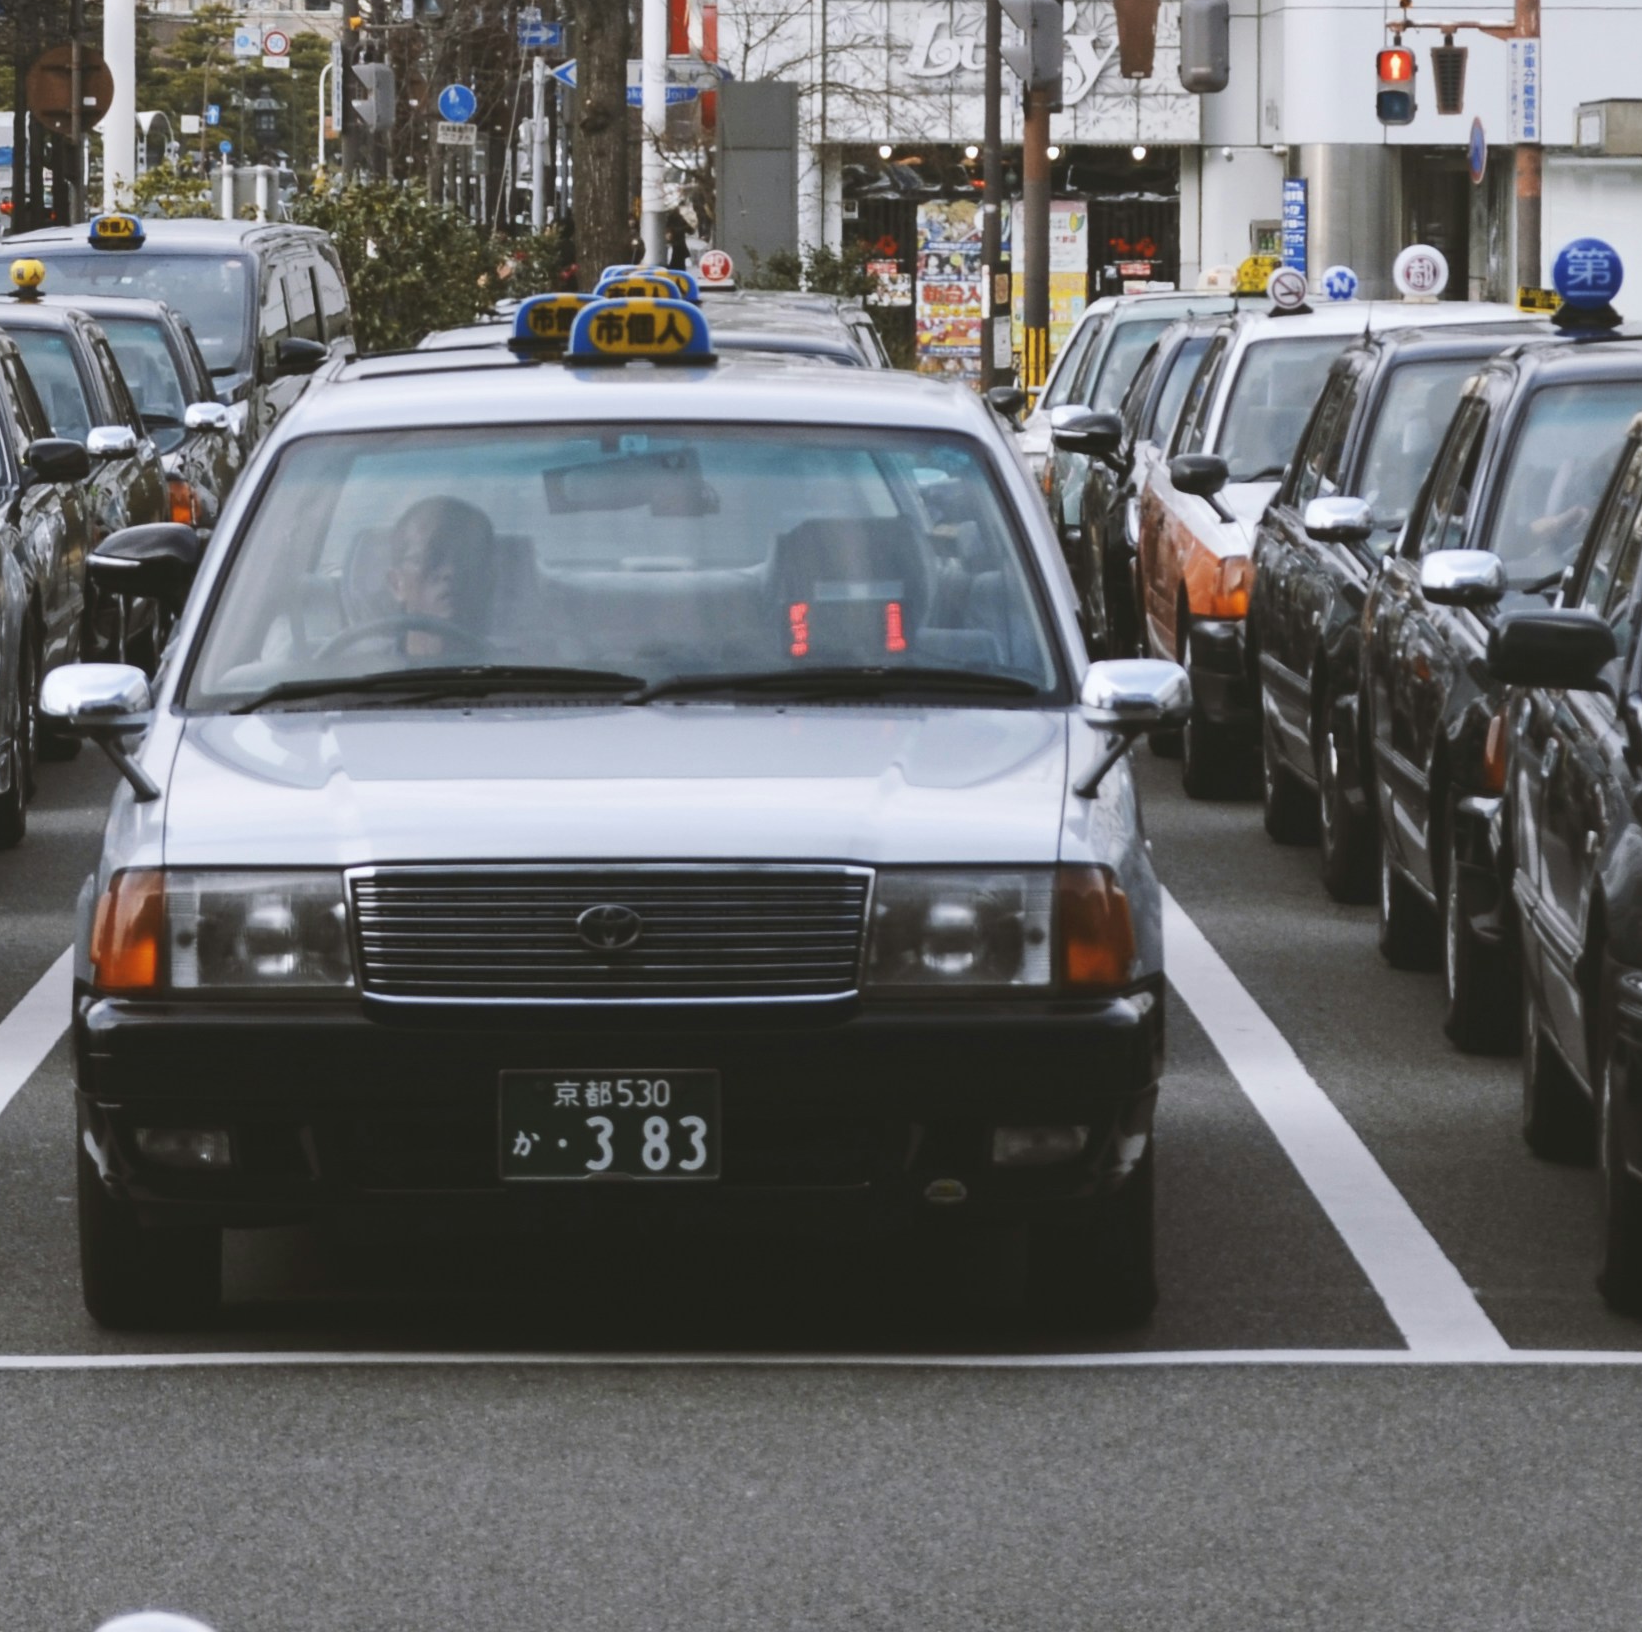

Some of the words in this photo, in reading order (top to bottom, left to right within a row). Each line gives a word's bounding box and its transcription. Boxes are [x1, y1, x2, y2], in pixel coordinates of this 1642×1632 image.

[1523, 42, 1535, 138] 歩車分離信号機
[1334, 277, 1348, 291] N
[596, 313, 686, 345] 市個人
[553, 1081, 612, 1107] 京都
[616, 1079, 670, 1107] 530
[513, 1130, 540, 1156] か
